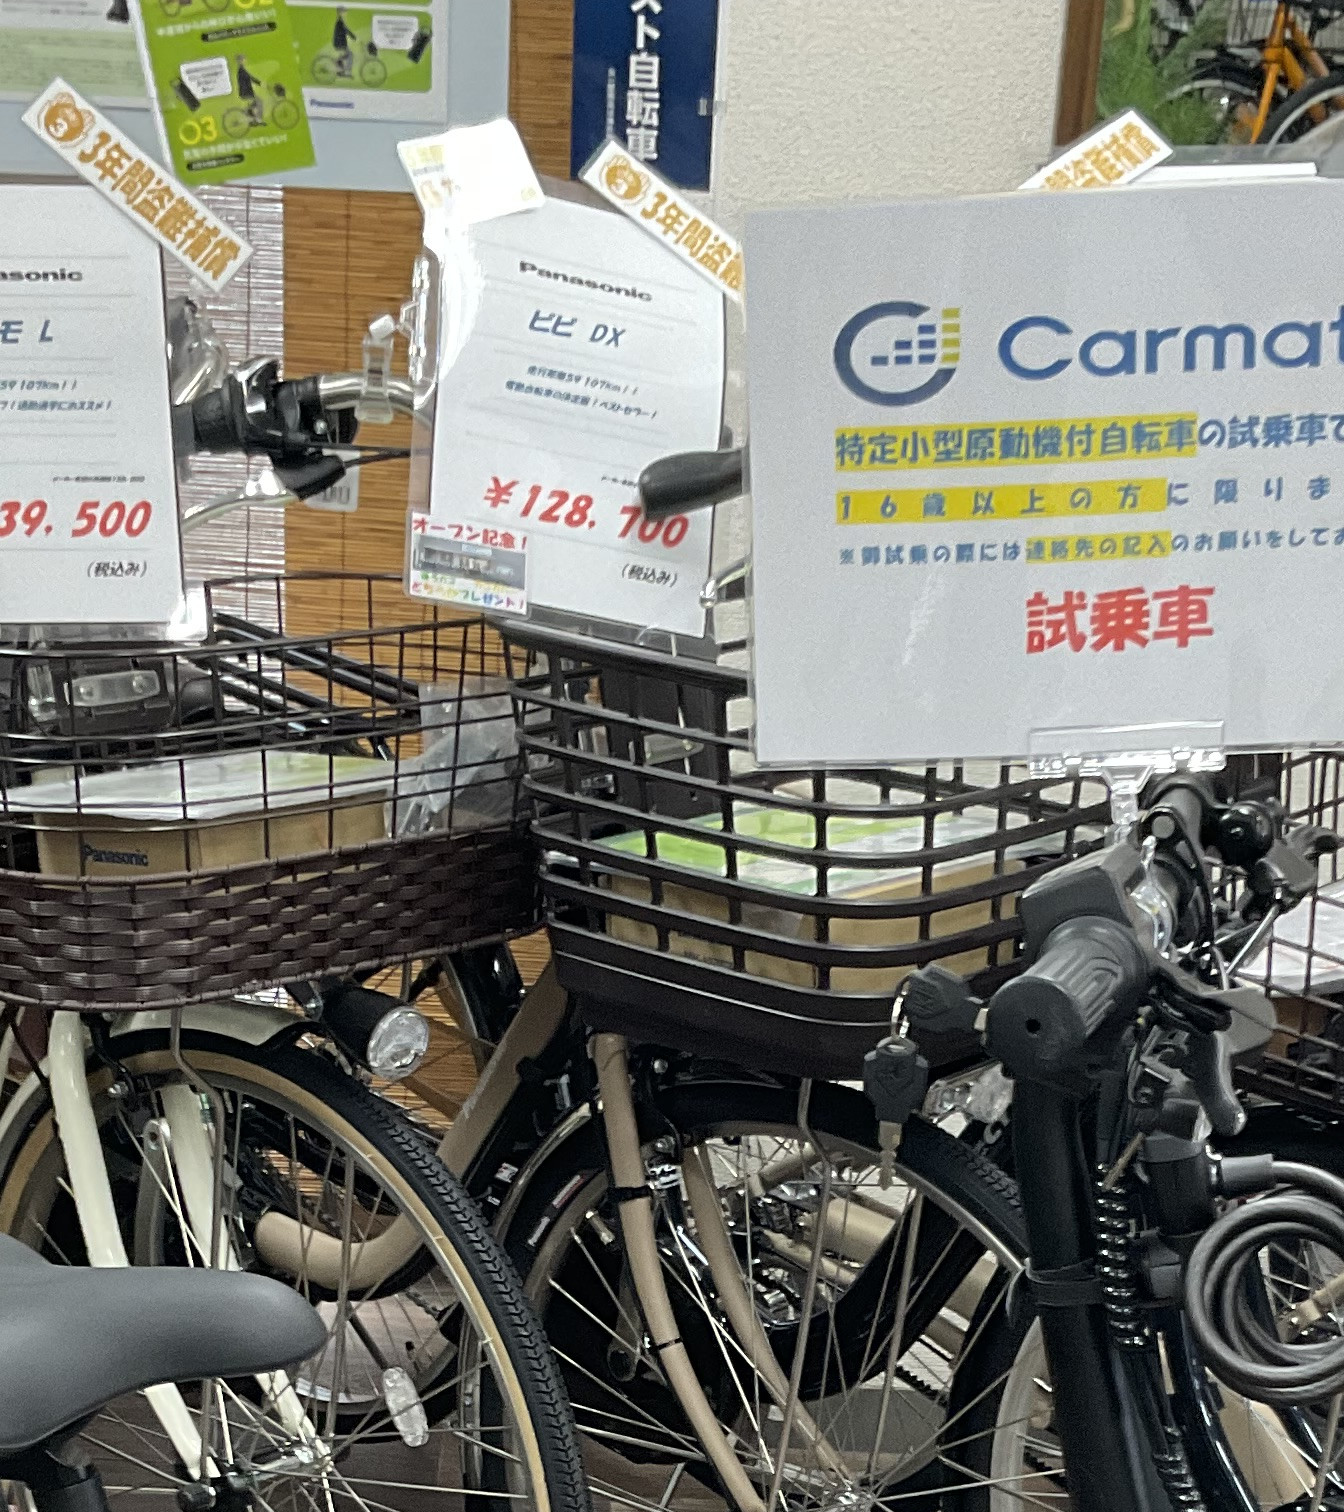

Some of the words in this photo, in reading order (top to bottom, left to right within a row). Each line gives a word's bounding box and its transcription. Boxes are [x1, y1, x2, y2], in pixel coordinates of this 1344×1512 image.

[178, 115, 218, 145] 03
[78, 130, 242, 282] 3年間盗難補償
[519, 260, 653, 302] Panasonic
[38, 319, 54, 343] L
[588, 323, 627, 348] DX
[1025, 583, 1216, 655] 試乗車
[81, 844, 149, 867] Panasonic
